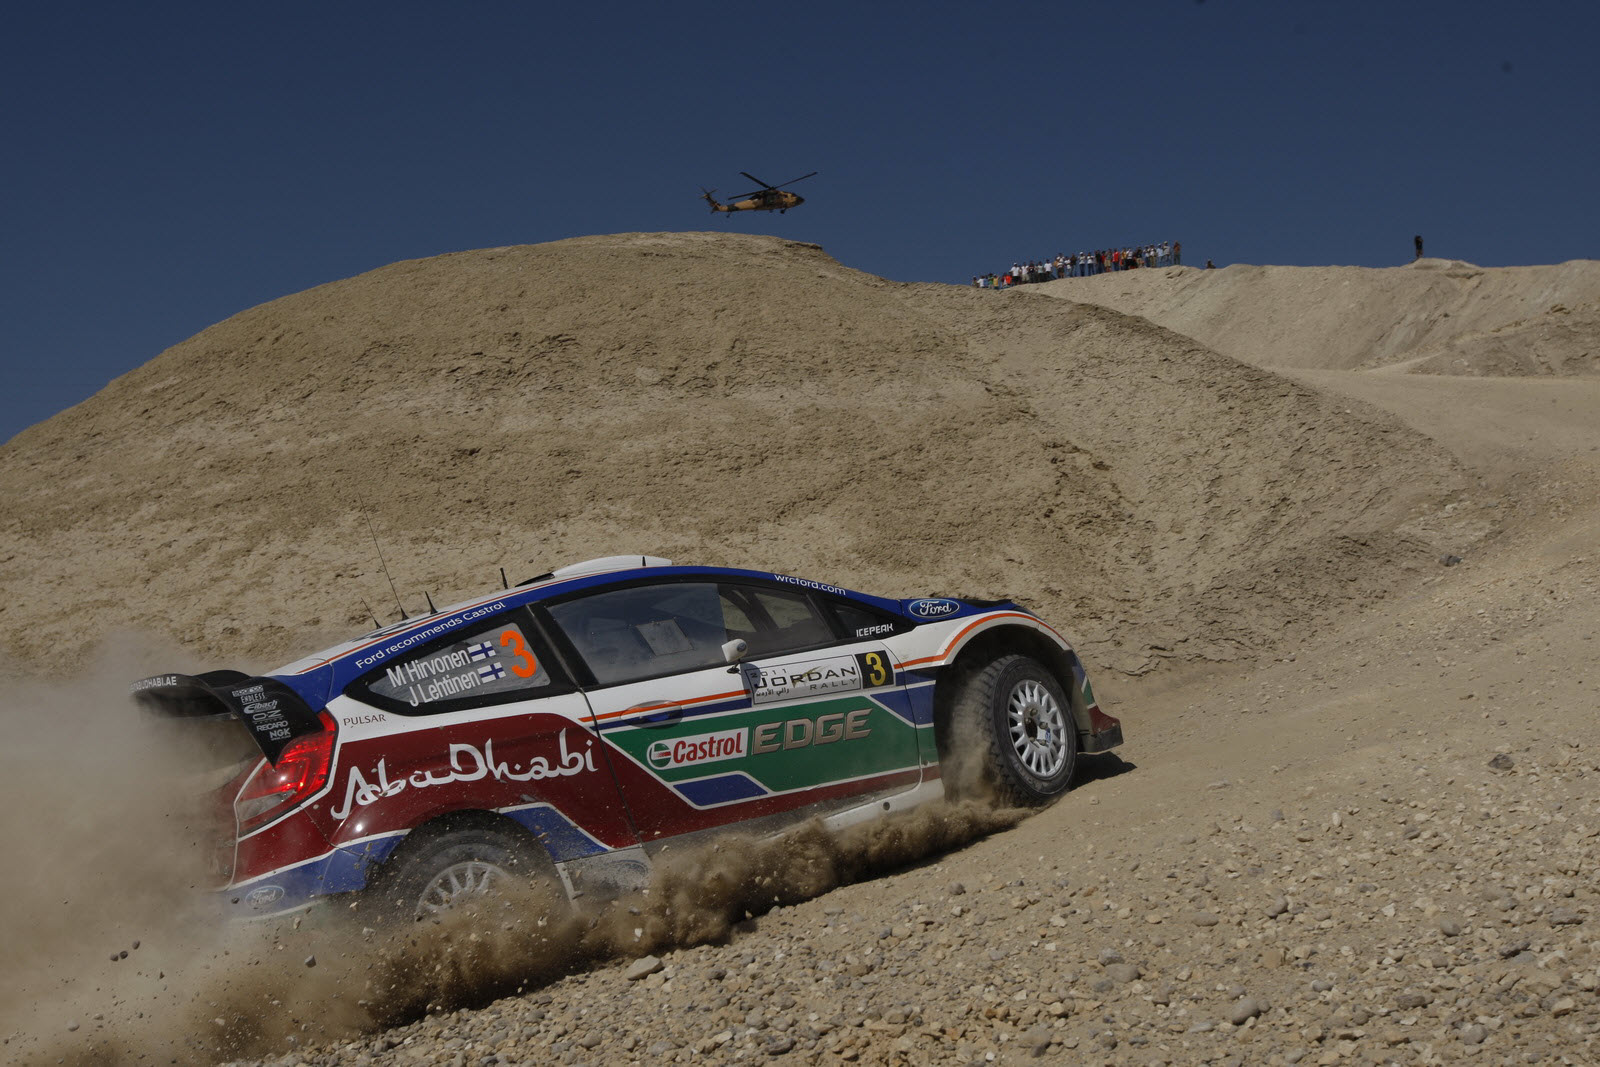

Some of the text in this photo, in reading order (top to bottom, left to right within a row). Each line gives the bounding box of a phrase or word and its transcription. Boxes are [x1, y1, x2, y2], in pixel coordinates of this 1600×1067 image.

[773, 574, 847, 596] wrcford.com
[919, 600, 952, 616] Ford
[355, 602, 506, 668] Ford recommends Castrol
[856, 623, 894, 637] ICEPEAK
[501, 630, 537, 679] 3
[386, 648, 471, 688] M Hirvonen
[750, 668, 787, 678] 2011
[754, 667, 857, 689] JORDAN
[865, 652, 887, 687] 3
[408, 669, 482, 707] J Lehtinen
[810, 678, 857, 690] RALLY
[256, 720, 289, 732] RECARO
[343, 713, 387, 727] PULSAR
[269, 727, 291, 739] NGK
[673, 708, 874, 764] Castrol EDGE
